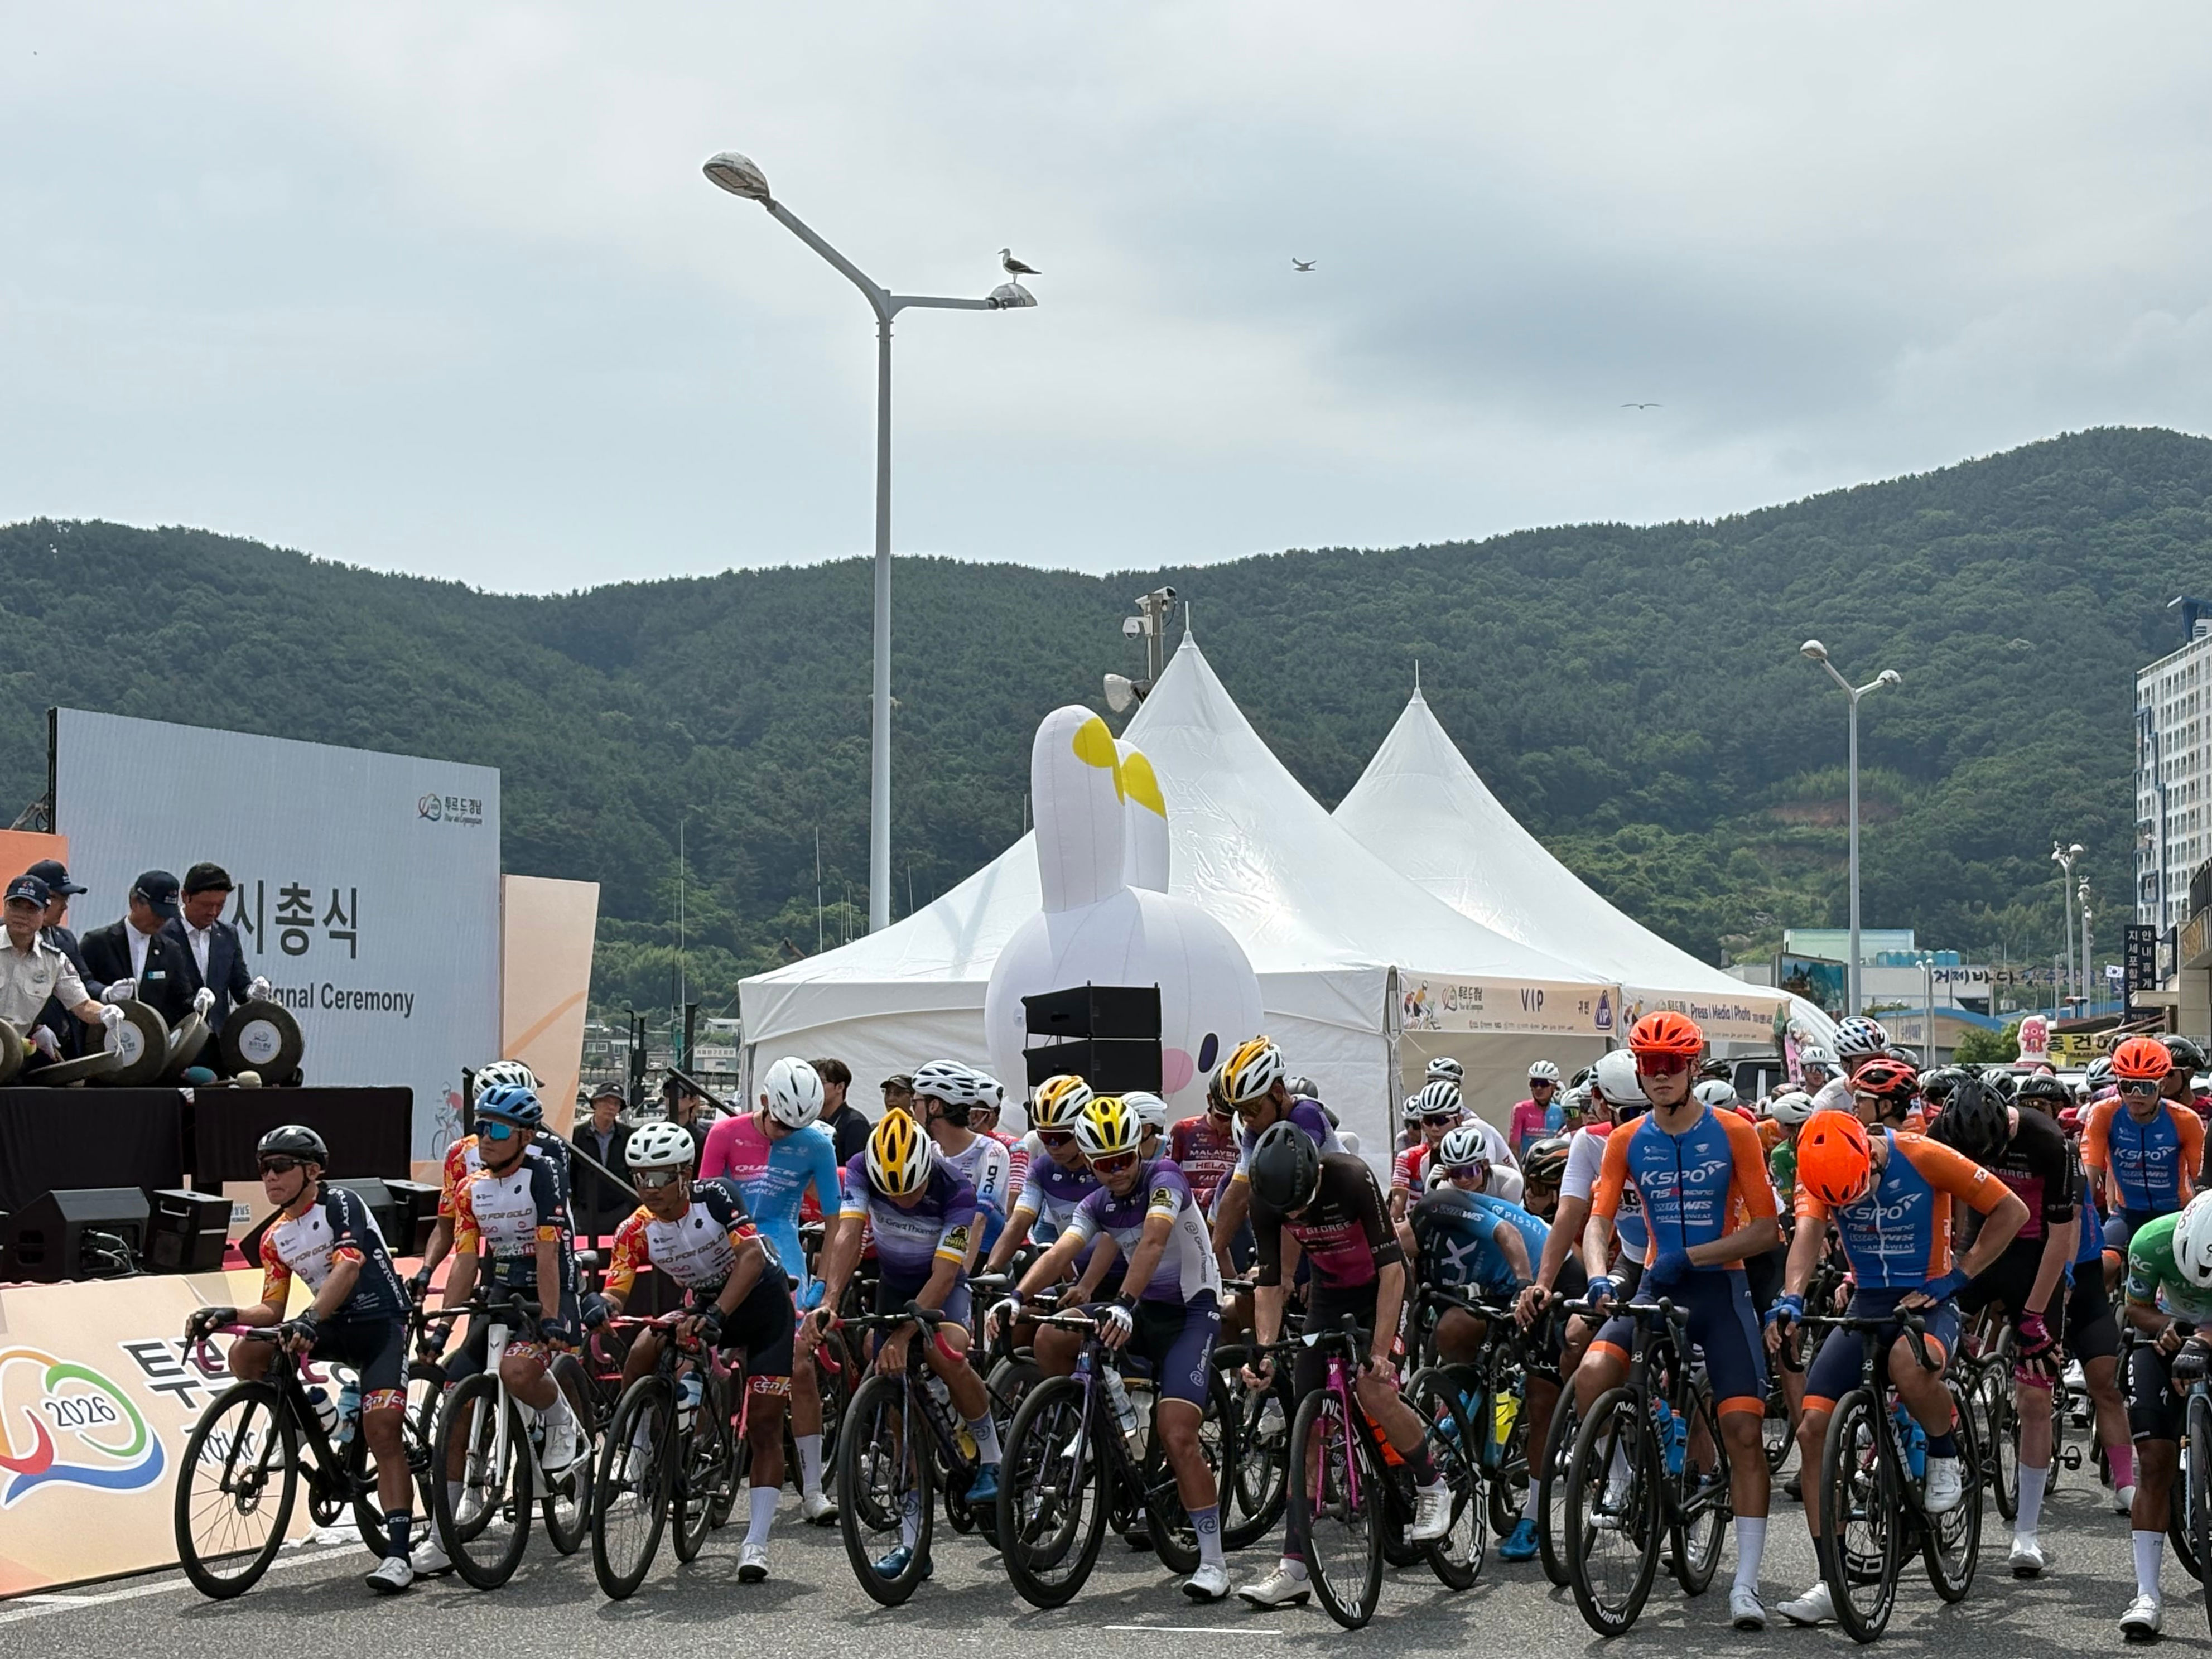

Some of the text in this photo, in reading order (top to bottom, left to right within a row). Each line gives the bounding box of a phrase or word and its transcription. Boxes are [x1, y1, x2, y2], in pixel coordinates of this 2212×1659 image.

[231, 880, 358, 960] 시총식
[321, 982, 415, 1019] Ceremony
[1520, 988, 1544, 1012] VIP
[1598, 1009, 1609, 1023] VIP
[1690, 1004, 1709, 1020] Press
[1712, 1004, 1731, 1020] Media
[1734, 1004, 1751, 1021] Photo
[1189, 1149, 1236, 1159] MALAYSI
[2114, 1146, 2161, 1161] KSPO
[1640, 1169, 1706, 1186] KSPO
[336, 1188, 350, 1226] RUDY
[487, 1212, 505, 1221] FOR
[505, 1207, 532, 1219] GOLD
[1838, 1205, 1903, 1221] KSPO
[886, 1218, 907, 1231] Grant
[1306, 1221, 1352, 1235] GEORGE
[1504, 1211, 1542, 1236] PISSEI
[674, 1250, 696, 1262] FOR
[697, 1231, 725, 1255] GOLD
[295, 1252, 311, 1265] FOR
[1194, 1236, 1207, 1283] Grant Thornton
[378, 1261, 405, 1308] STORCK
[45, 1396, 116, 1428] 2026
